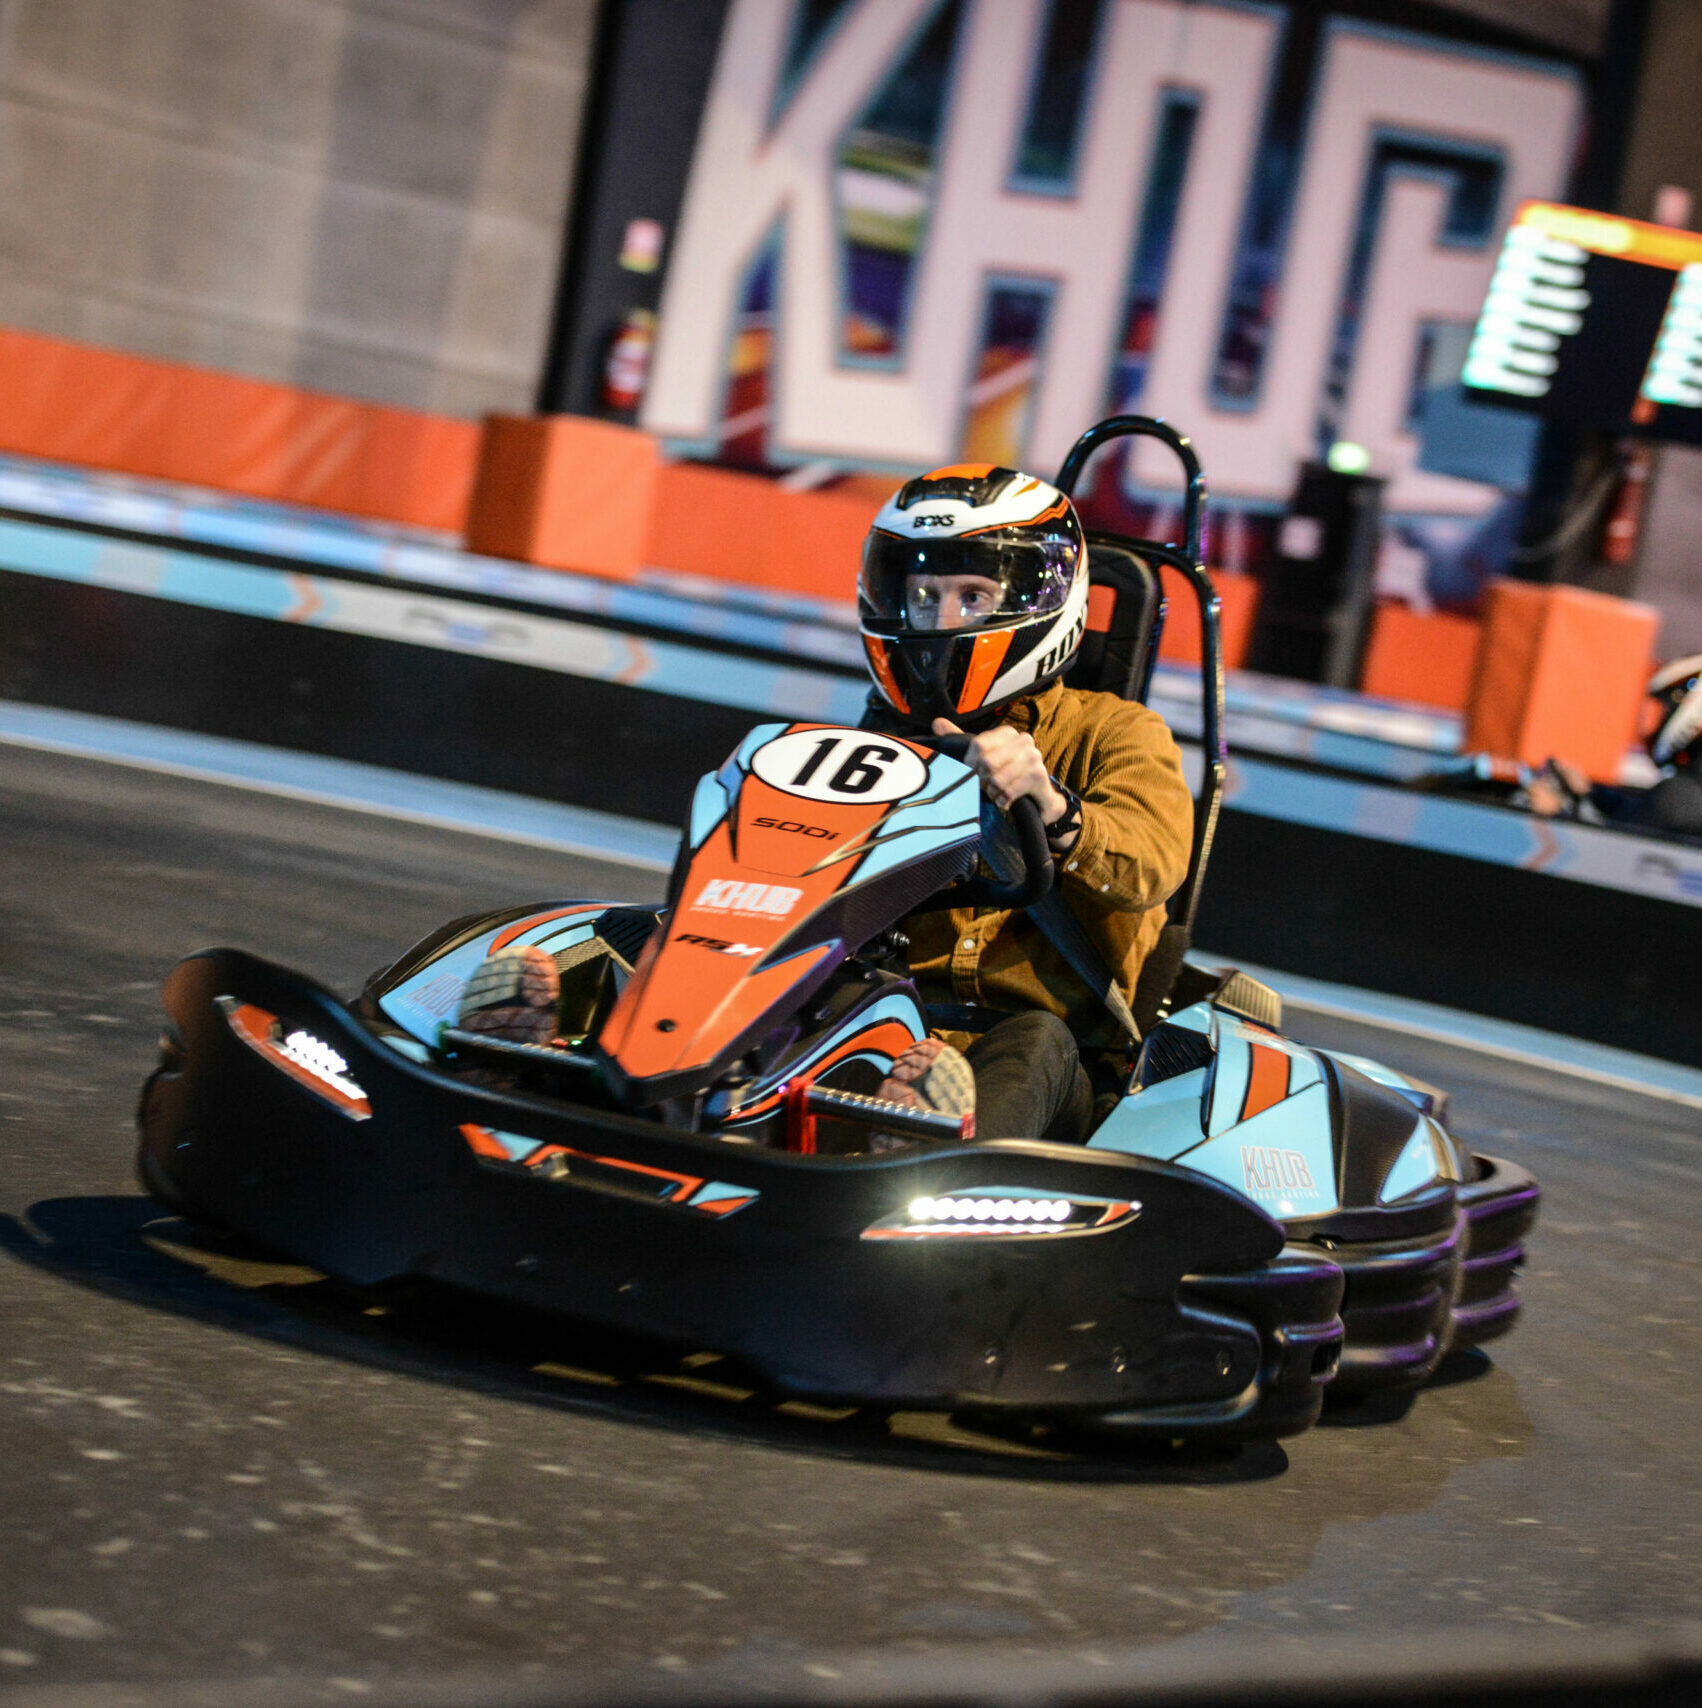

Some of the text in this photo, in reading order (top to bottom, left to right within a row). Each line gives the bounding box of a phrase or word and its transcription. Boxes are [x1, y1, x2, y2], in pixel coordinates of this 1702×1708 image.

[913, 514, 955, 528] BOXS
[790, 738, 899, 794] 16
[692, 879, 804, 915] KHUB
[1240, 1145, 1316, 1190] KHUB
